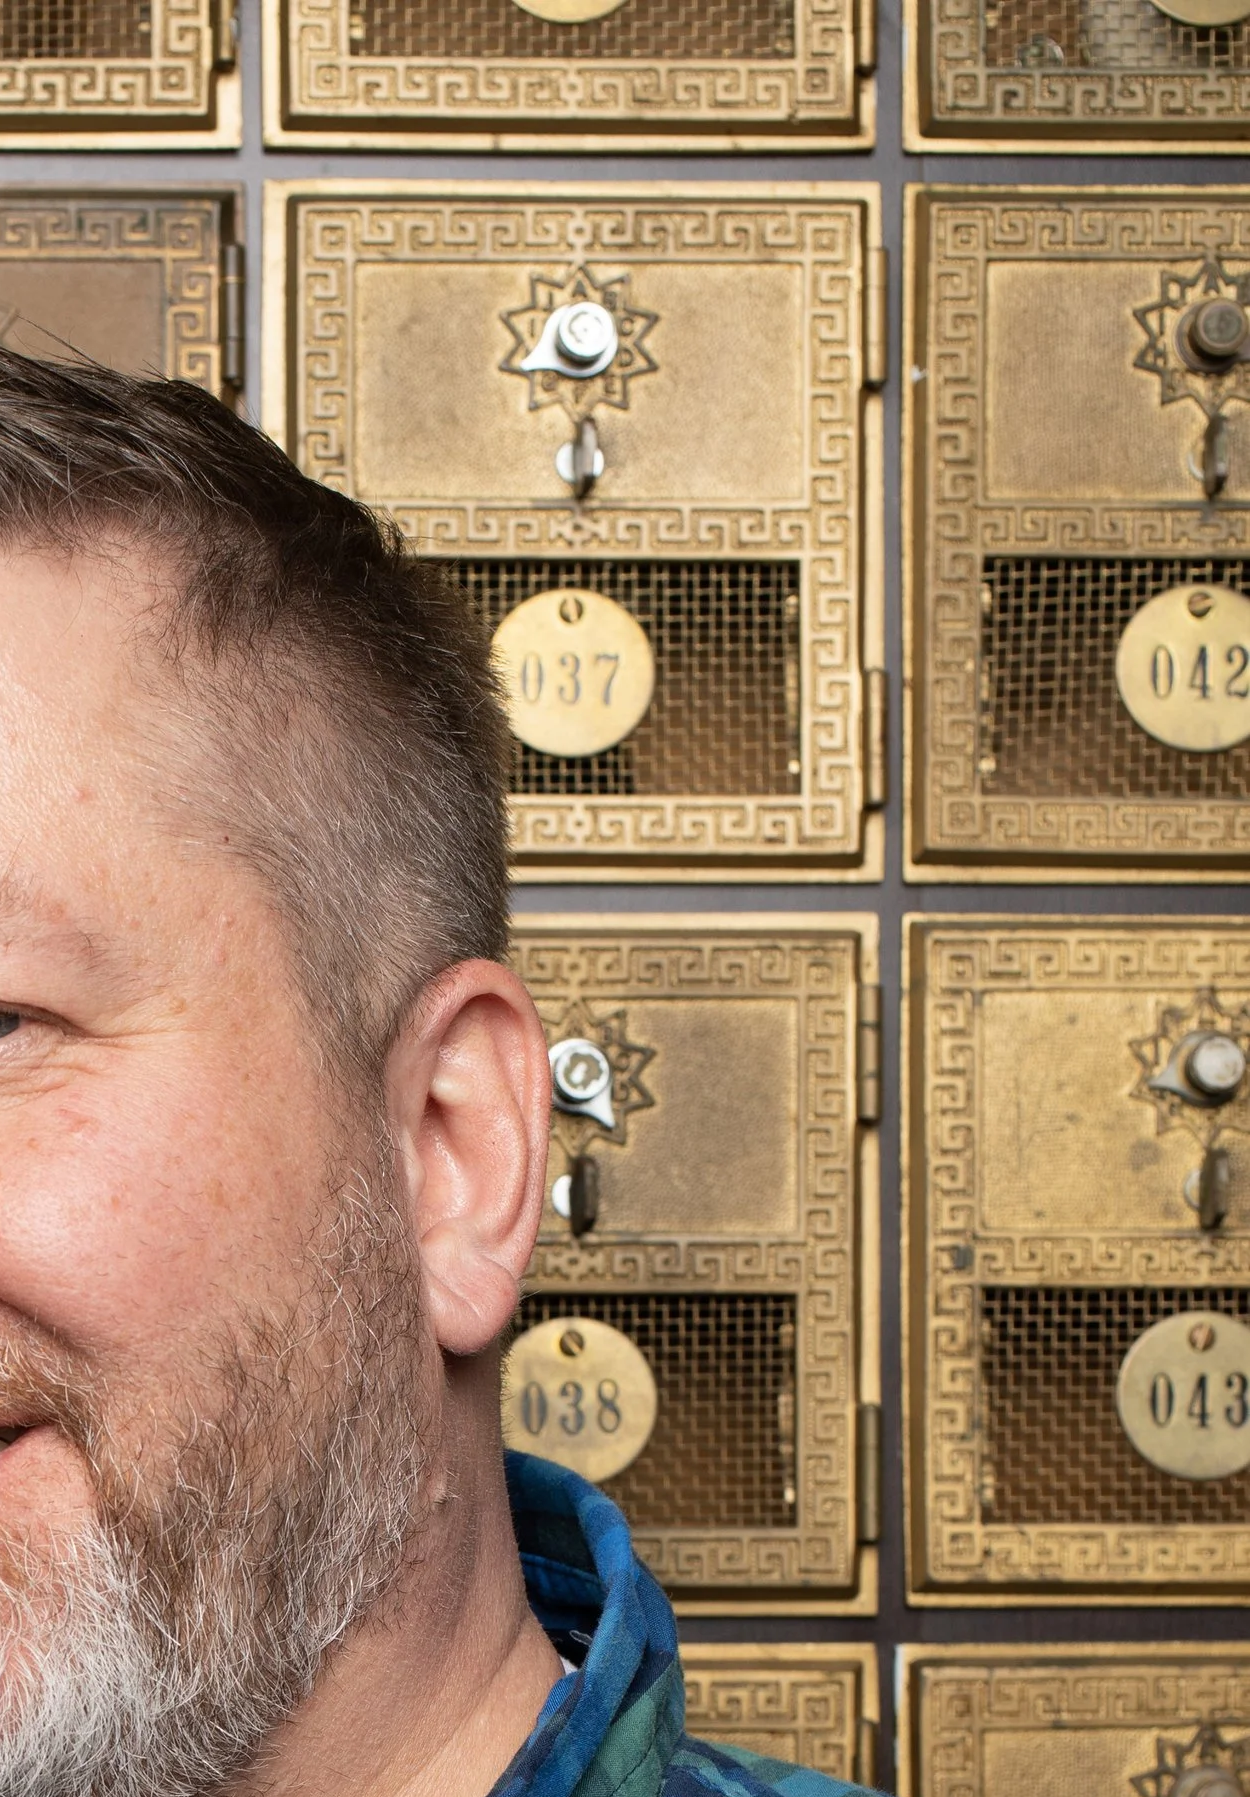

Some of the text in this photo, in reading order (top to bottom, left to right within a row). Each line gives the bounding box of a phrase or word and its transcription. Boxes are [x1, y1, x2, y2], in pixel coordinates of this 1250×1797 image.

[520, 651, 620, 708] 037
[1151, 643, 1250, 701] 042
[520, 1378, 623, 1436] 038
[1150, 1371, 1250, 1429] 043
